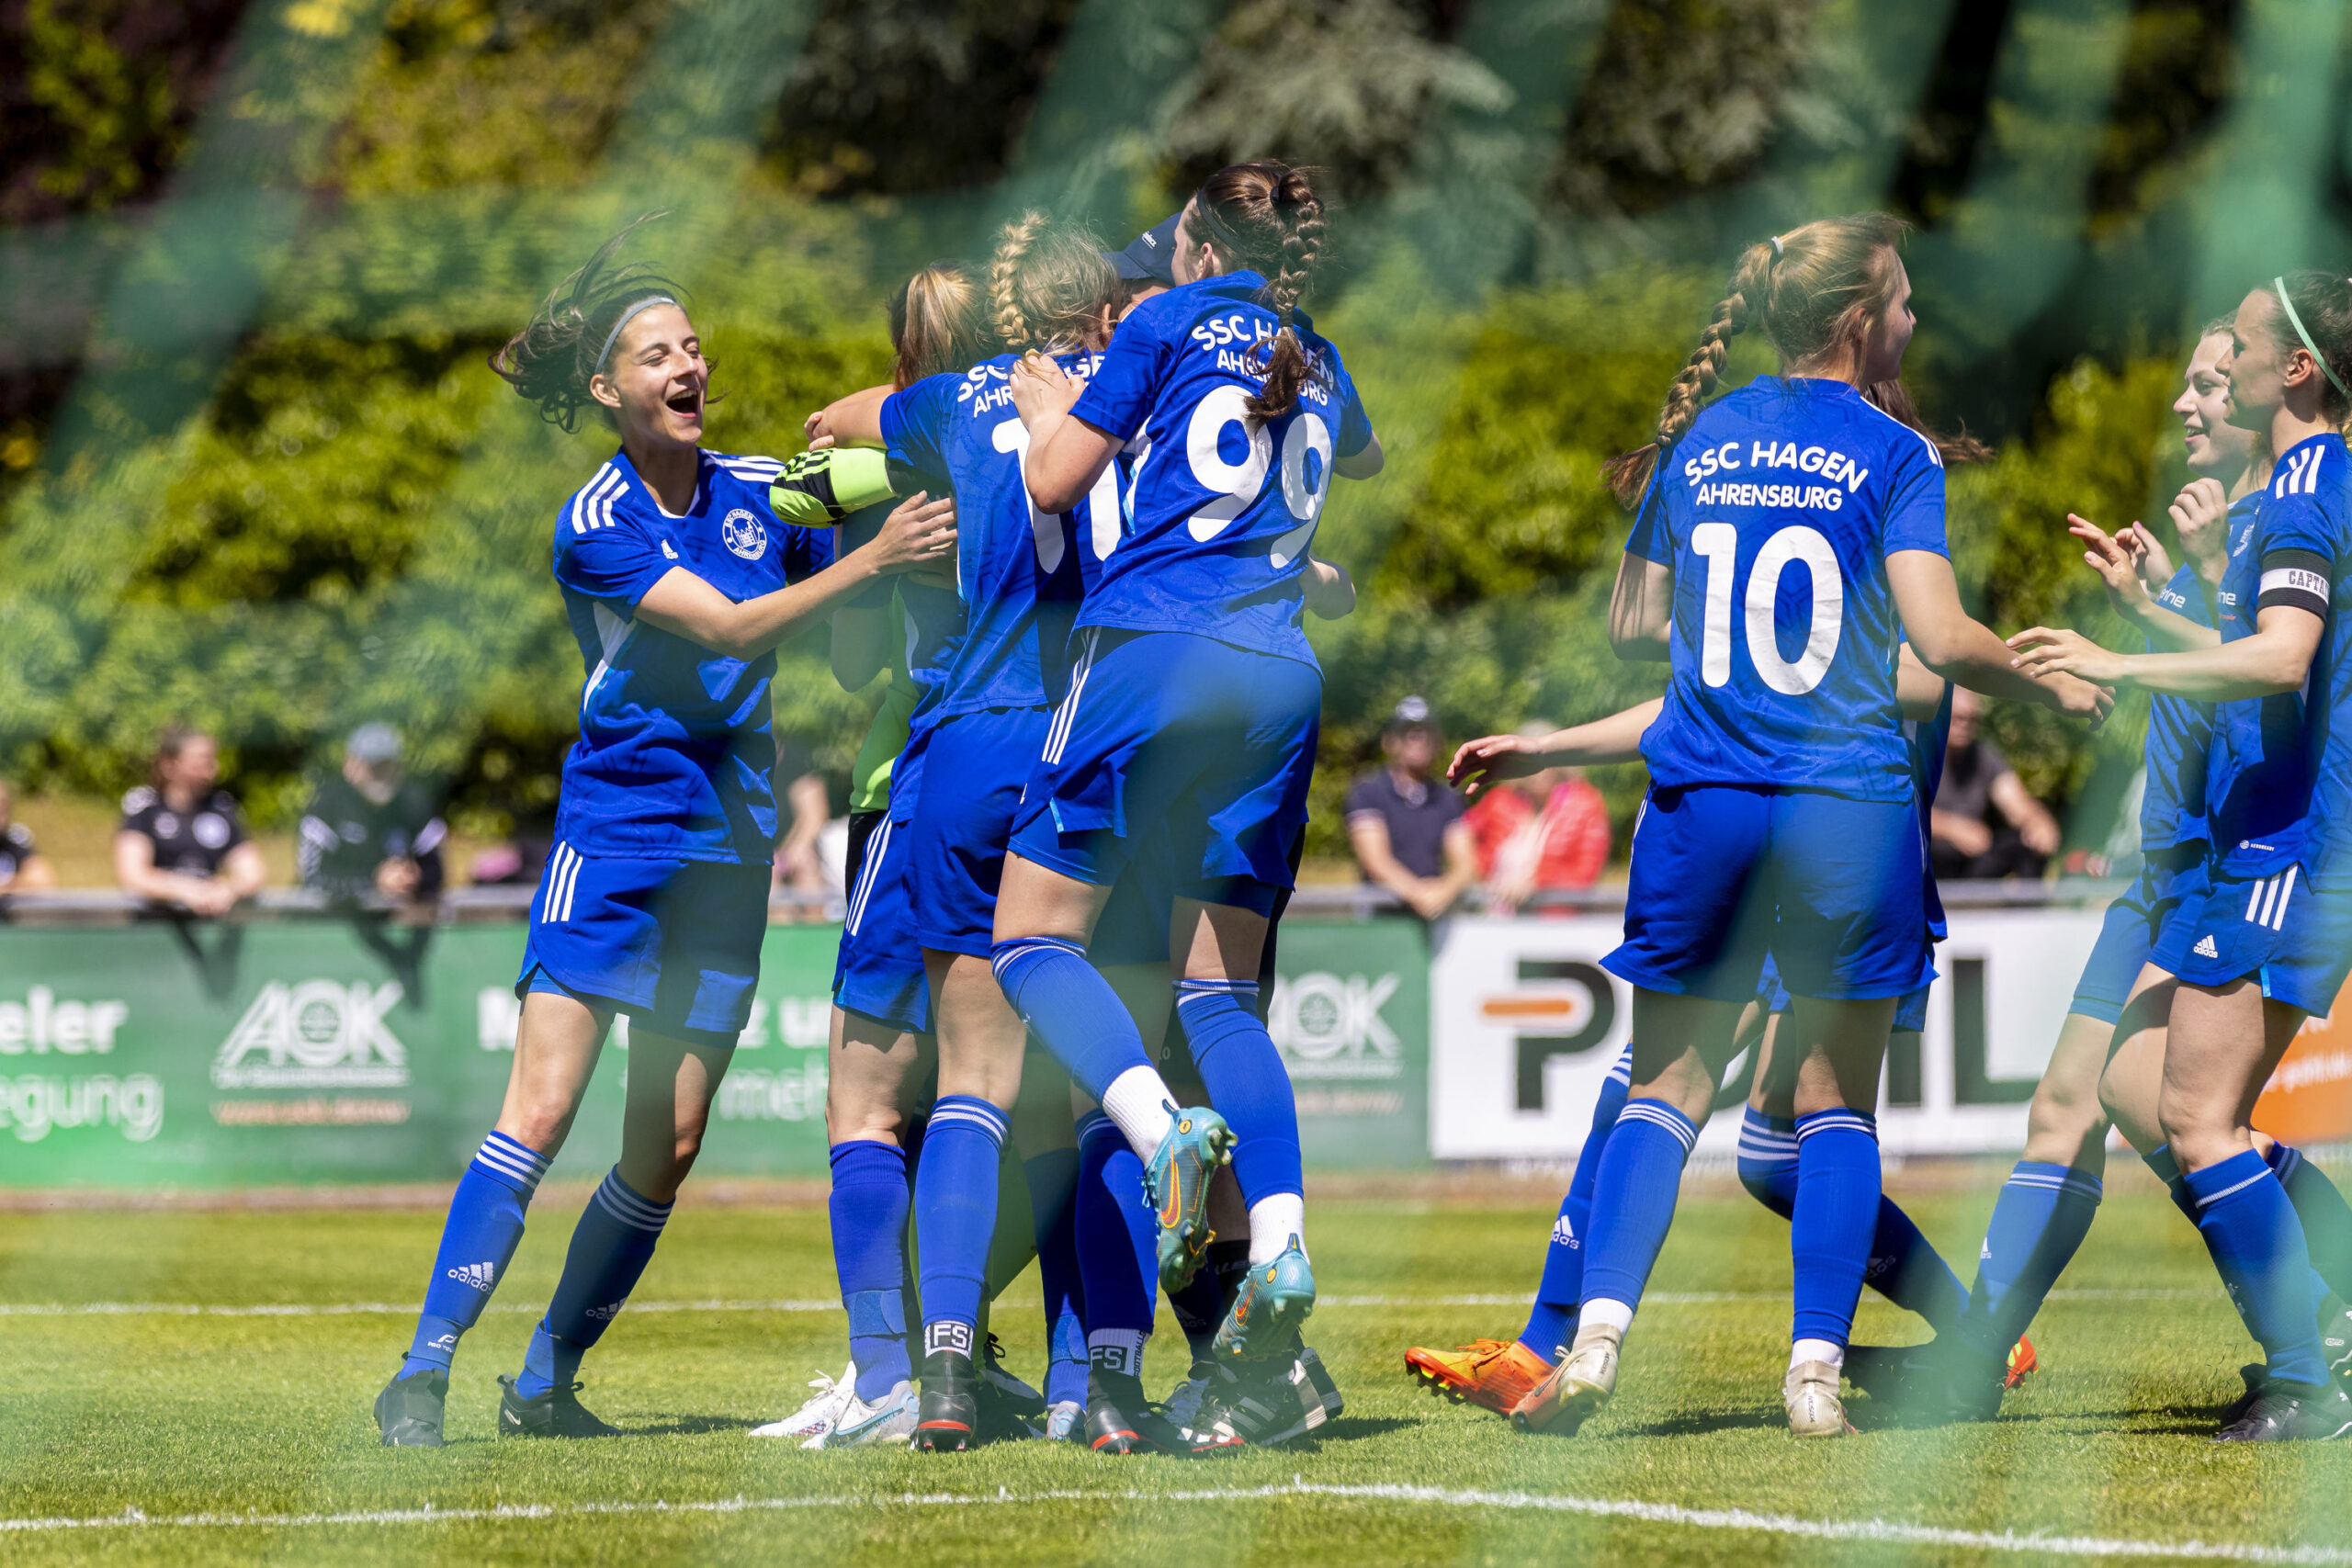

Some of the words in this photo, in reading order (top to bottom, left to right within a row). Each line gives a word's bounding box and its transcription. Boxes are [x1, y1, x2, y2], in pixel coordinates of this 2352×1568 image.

[1192, 315, 1251, 352] SSC
[1187, 384, 1332, 570] 99
[1684, 441, 1741, 487] SSC
[1749, 440, 1869, 493] HAGEN
[1695, 482, 1843, 512] AHRENSBURG
[1690, 522, 1844, 696] 10
[2193, 944, 2219, 959] adidas
[213, 978, 410, 1067] AOK
[1268, 971, 1402, 1060] OK
[447, 1269, 494, 1295] adidas
[427, 1340, 442, 1349] PRO
[933, 1324, 968, 1348] FS
[1090, 1347, 1123, 1371] FS
